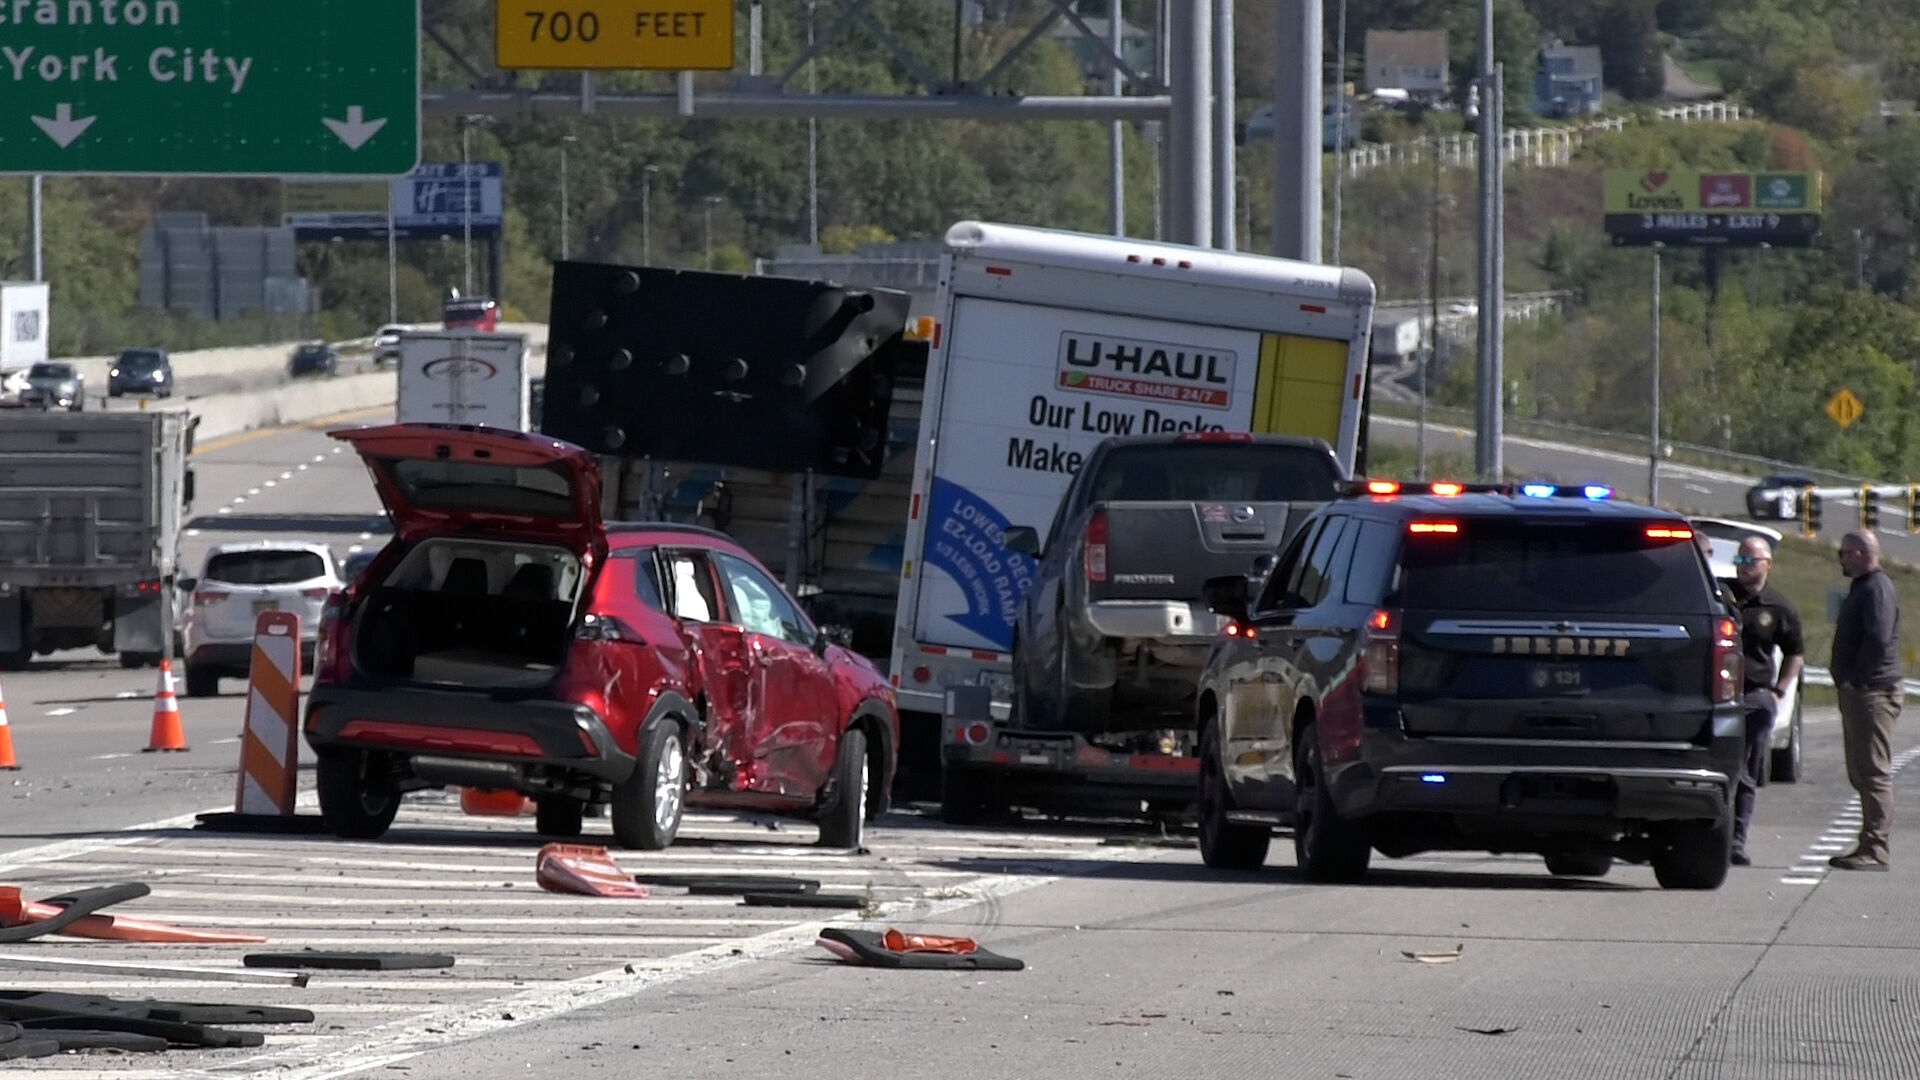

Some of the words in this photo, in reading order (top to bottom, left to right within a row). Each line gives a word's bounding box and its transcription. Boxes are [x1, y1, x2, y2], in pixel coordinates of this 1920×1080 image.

[525, 11, 599, 42] 700
[635, 12, 706, 37] FEET
[2, 46, 119, 82] York
[148, 46, 254, 94] City
[1656, 213, 1708, 230] MILES
[1728, 213, 1764, 230] EXIT
[1066, 338, 1227, 384] U-HAUL
[1088, 377, 1132, 393] TRUCK
[1134, 381, 1178, 398] SHARE
[1181, 388, 1215, 402] 24/7
[1029, 395, 1076, 430] Our
[1081, 401, 1135, 436] Low
[1007, 437, 1083, 476] Make
[953, 499, 1007, 551] LOWES
[1007, 553, 1033, 595] DEC
[943, 517, 1002, 574] EZ-LOAD
[994, 575, 1018, 627] RAMP
[950, 551, 978, 580] LESS
[971, 578, 991, 617] WORK
[1113, 573, 1175, 585] FRONTIER
